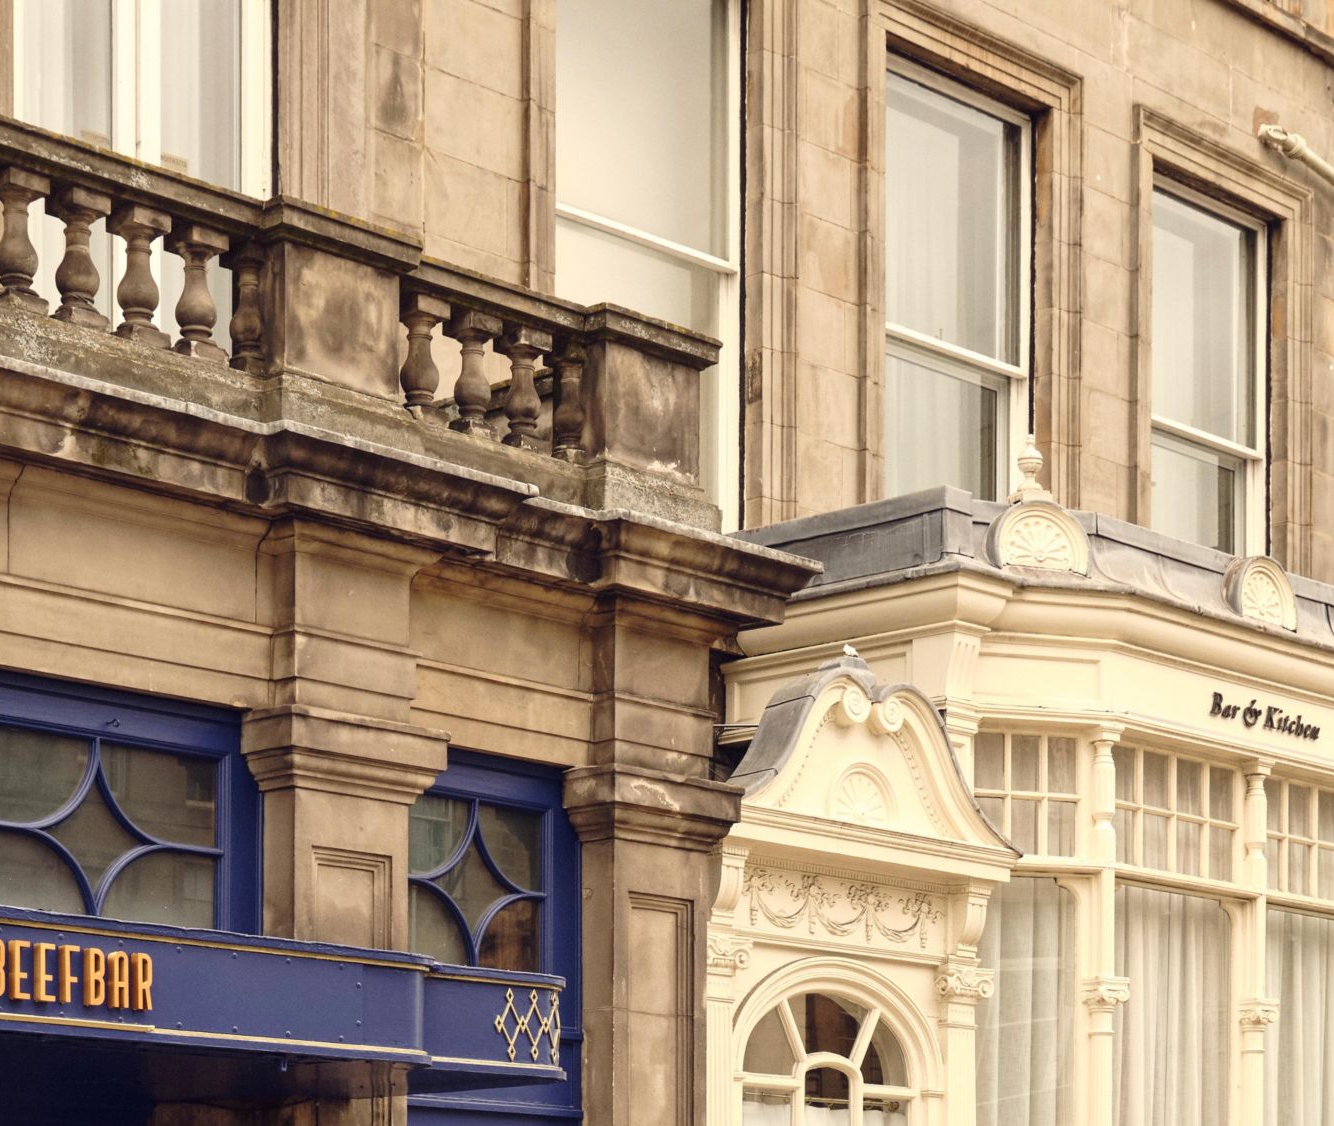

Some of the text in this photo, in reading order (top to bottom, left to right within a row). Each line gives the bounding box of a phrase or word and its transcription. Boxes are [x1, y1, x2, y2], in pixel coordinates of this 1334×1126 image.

[1210, 692, 1320, 740] Bar & Kitchen
